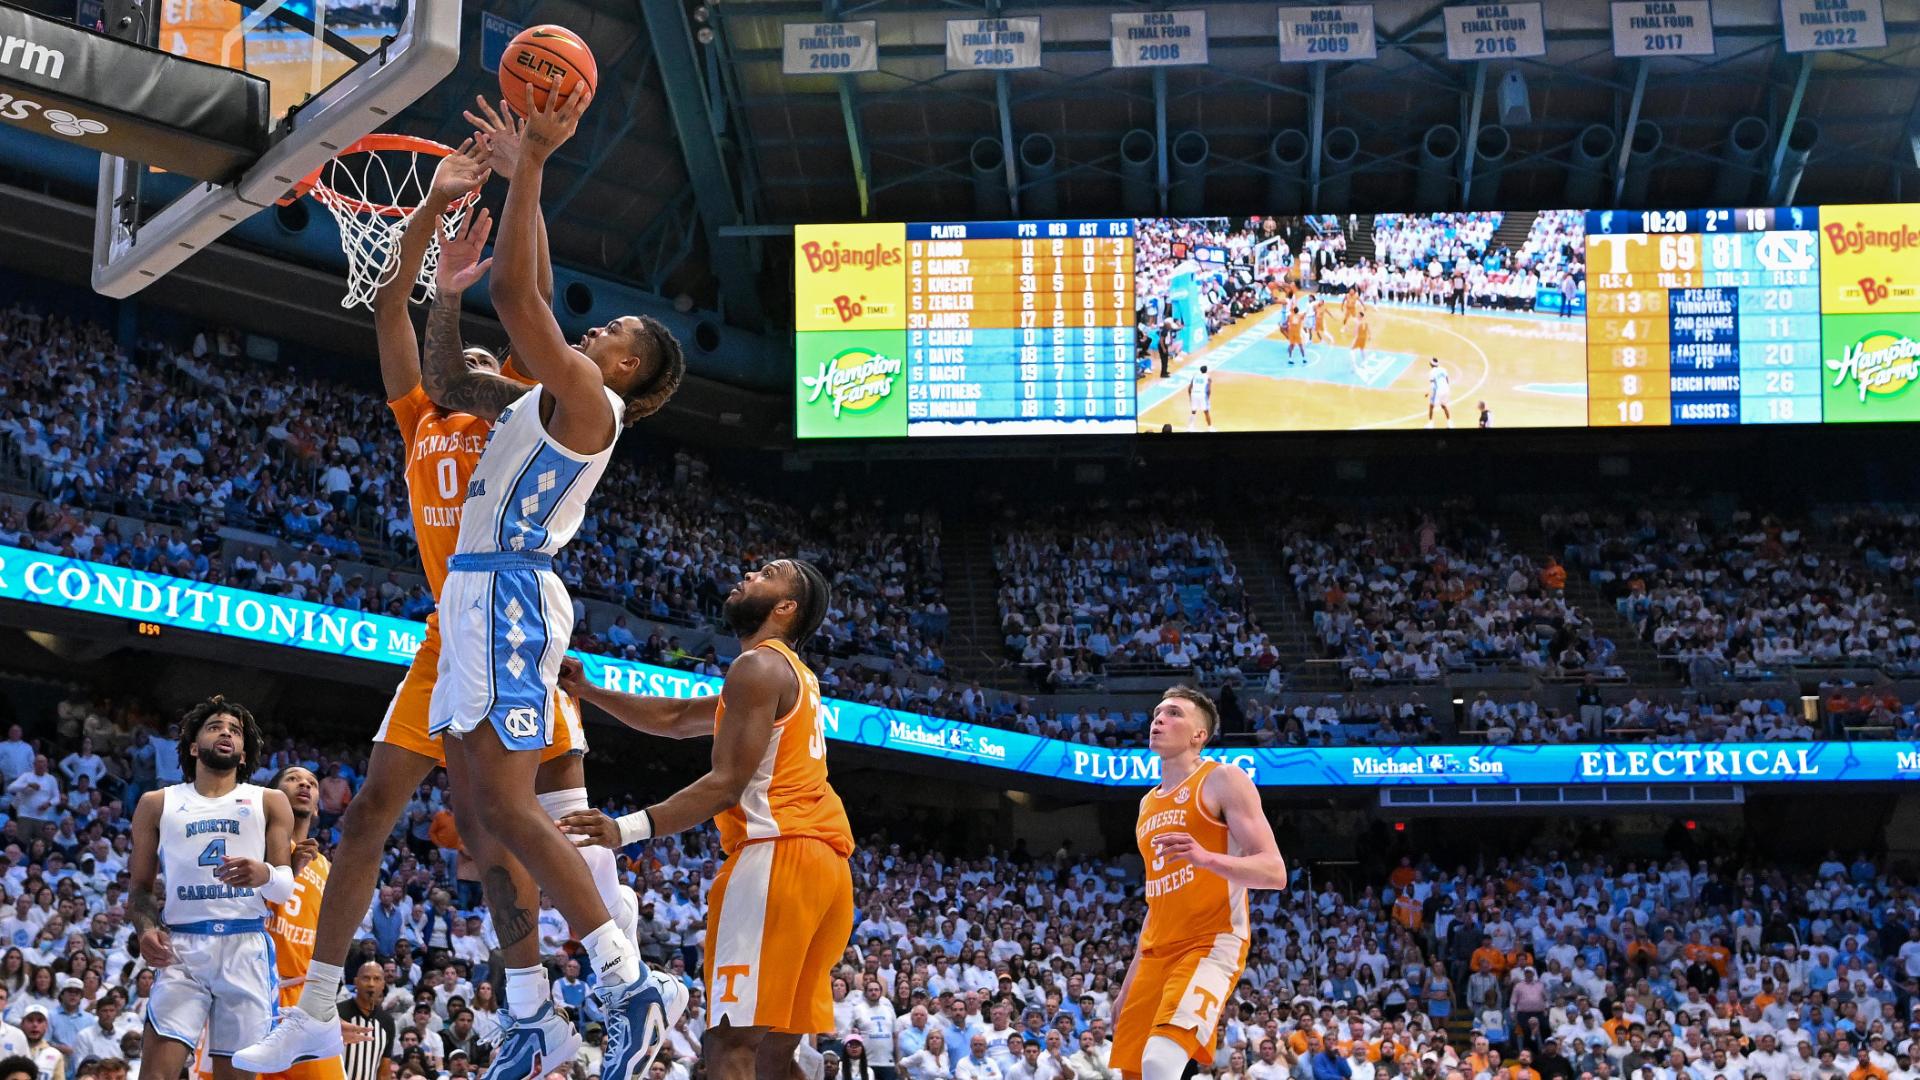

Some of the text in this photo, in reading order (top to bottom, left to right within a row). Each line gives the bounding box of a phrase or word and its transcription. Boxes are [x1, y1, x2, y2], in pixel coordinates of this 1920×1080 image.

[1310, 10, 1342, 21] NCAA
[1476, 6, 1509, 19] NCAA
[1645, 3, 1676, 15] NCAA
[1800, 10, 1866, 25] FINAL FOUR
[1143, 14, 1175, 26] NCAA
[1295, 22, 1359, 35] FINAL FOUR
[1462, 19, 1526, 33] FINAL FOUR
[1630, 16, 1694, 29] FINAL FOUR
[963, 32, 1025, 46] FINAL FOUR
[1128, 25, 1191, 40] FINAL FOUR
[1813, 28, 1857, 46] 2022
[799, 36, 861, 50] FINAL FOUR
[1307, 37, 1349, 53] 2009
[1475, 37, 1517, 54] 2016
[1644, 34, 1683, 50] 2017
[810, 53, 850, 69] 2000
[974, 48, 1014, 64] 2005
[1139, 44, 1180, 60] 2008
[517, 51, 568, 79] ELITE
[931, 222, 1128, 238] PLAYER PTS REB AST FLS
[1642, 211, 1687, 232] 10:20
[1824, 222, 1920, 255] Bojangle
[801, 241, 902, 273] Bojangles
[912, 239, 1124, 257] 0 11 2 0 3
[1589, 234, 1648, 273] T
[1659, 236, 1695, 270] 69
[1712, 235, 1742, 269] 81
[912, 259, 922, 274] 2
[1054, 257, 1062, 273] 1
[1083, 257, 1094, 273] 0
[1115, 256, 1122, 273] 1
[912, 274, 1125, 292] 3 KNECHT 31 5 1 0
[1600, 274, 1633, 287] FLS: 4
[1684, 273, 1692, 286] 3
[1742, 272, 1750, 285] 3
[1774, 271, 1797, 285] FLS:
[912, 292, 1125, 310] 5 ZEIGLER 2 1 3
[1616, 293, 1642, 313] 13
[1685, 289, 1722, 301] PTS OFF
[1764, 290, 1793, 310] 20
[1676, 301, 1732, 314] TURNOVERS
[908, 310, 1123, 328] 30 JAMES 17 2 0 1
[1674, 316, 1733, 329] 2ND CHANCE
[1767, 318, 1790, 337] 11
[913, 330, 922, 345] 2
[1023, 329, 1035, 345] 0
[1053, 328, 1064, 344] 2
[1083, 328, 1095, 344] 9
[1114, 328, 1125, 344] 2
[1621, 320, 1636, 340] 4
[1695, 329, 1714, 341] PTS
[914, 345, 1126, 363] 4 DAVIS 18 2 2 0
[1622, 347, 1637, 367] 8
[1677, 344, 1732, 357] FASTBREAK
[1765, 345, 1793, 365] 20
[913, 366, 923, 381] 5
[1021, 364, 1037, 380] 19
[1055, 363, 1064, 380] 7
[1084, 363, 1095, 380] 3
[1115, 362, 1126, 379] 3
[1695, 357, 1714, 369] PTS
[808, 353, 902, 403] Hampton
[1623, 375, 1637, 395] 8
[1671, 376, 1740, 392] BENCH POINTS
[1766, 372, 1793, 392] 26
[1858, 360, 1919, 402] Farms
[832, 375, 893, 418] Farms
[909, 381, 1126, 399] 24 WITHERS 0 1 1 2
[909, 402, 928, 417] 55
[1021, 400, 1038, 417] 18
[1055, 399, 1065, 416] 3
[1084, 399, 1096, 416] 0
[1115, 398, 1126, 415] 0
[1617, 401, 1644, 422] 10
[1681, 404, 1730, 419] ASSISTS
[1768, 400, 1793, 420] 18
[437, 457, 458, 499] 0
[24, 561, 378, 651] CONDITIONING
[889, 720, 1006, 757] Michael Son
[1352, 757, 1503, 774] Michael Son
[1581, 749, 1818, 776] ELECTRICAL
[185, 819, 240, 838] NORTH
[198, 838, 227, 878] 4
[1151, 835, 1165, 871] 3
[177, 884, 254, 901] CAROLINA
[284, 883, 305, 917] 5
[717, 964, 750, 1003] T
[1193, 985, 1219, 1021] T
